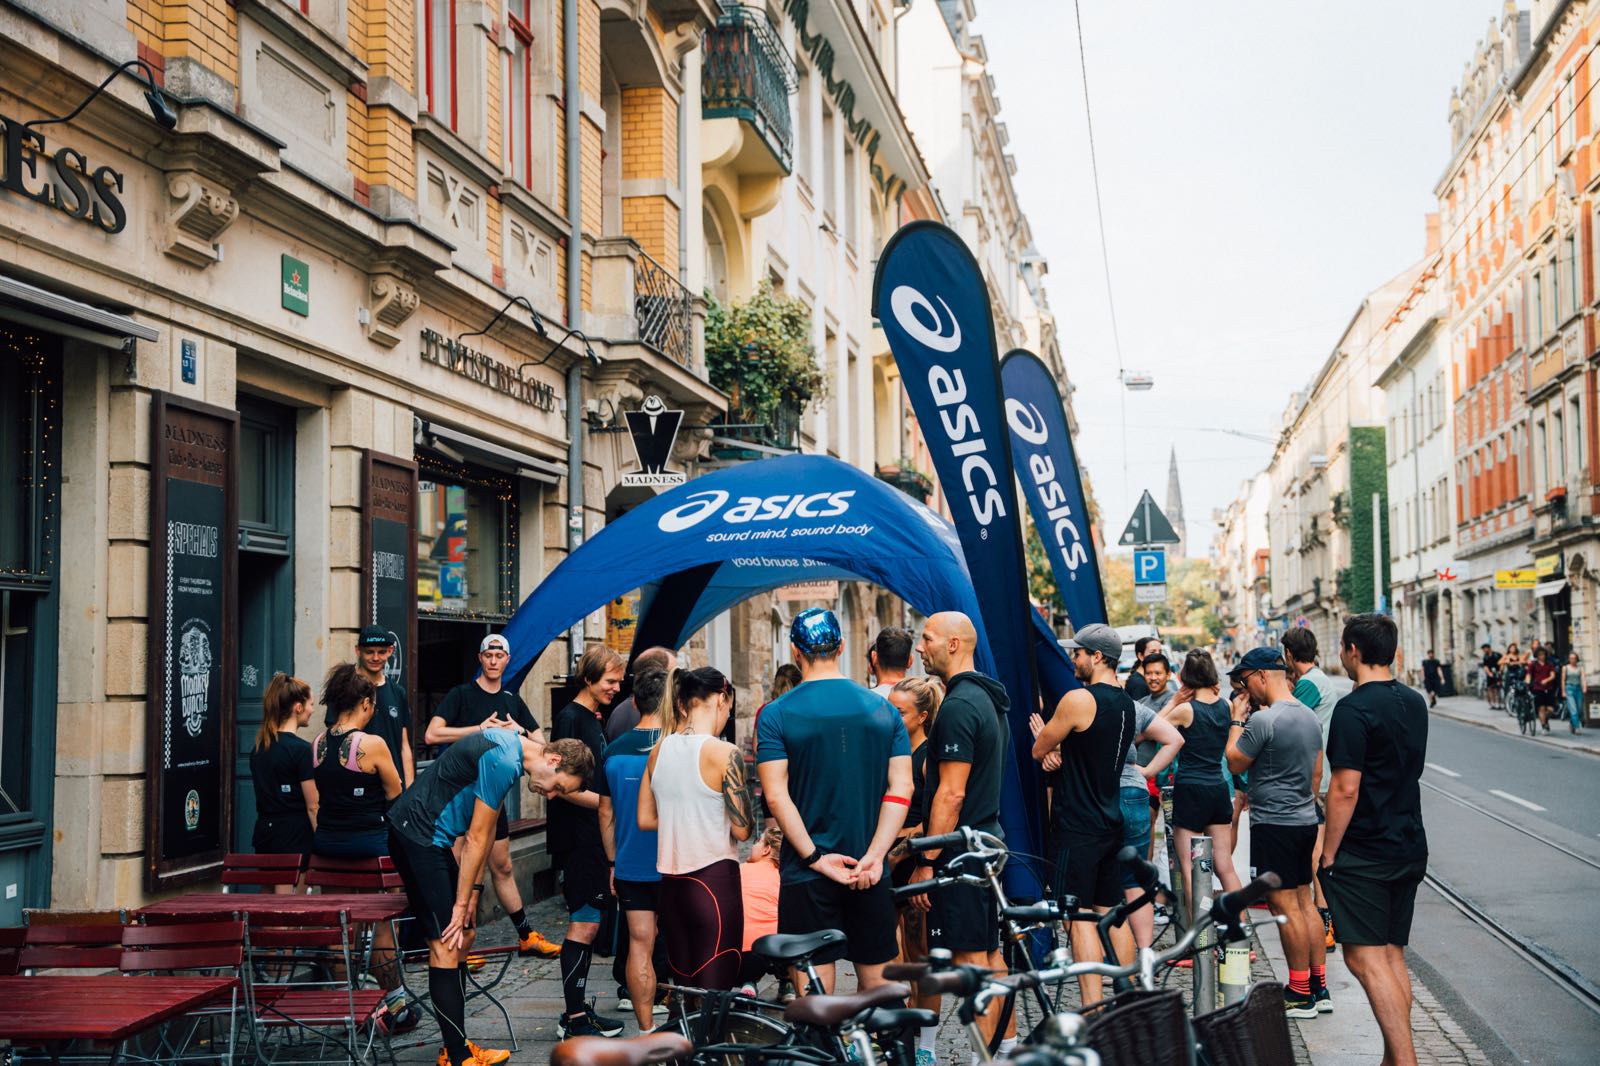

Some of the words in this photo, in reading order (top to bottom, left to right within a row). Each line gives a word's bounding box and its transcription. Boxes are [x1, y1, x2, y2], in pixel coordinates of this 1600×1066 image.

[447, 338, 493, 386] MUST
[496, 361, 516, 395] BE
[519, 371, 556, 413] LOVE
[165, 423, 226, 453] MADNESS
[624, 476, 684, 485] MADNESS
[723, 490, 856, 524] asics
[174, 521, 218, 557] SPECIALS
[706, 529, 751, 543] sound
[751, 528, 788, 541] mind,
[791, 524, 836, 538] sound
[835, 523, 875, 537] body
[1141, 556, 1158, 579] P
